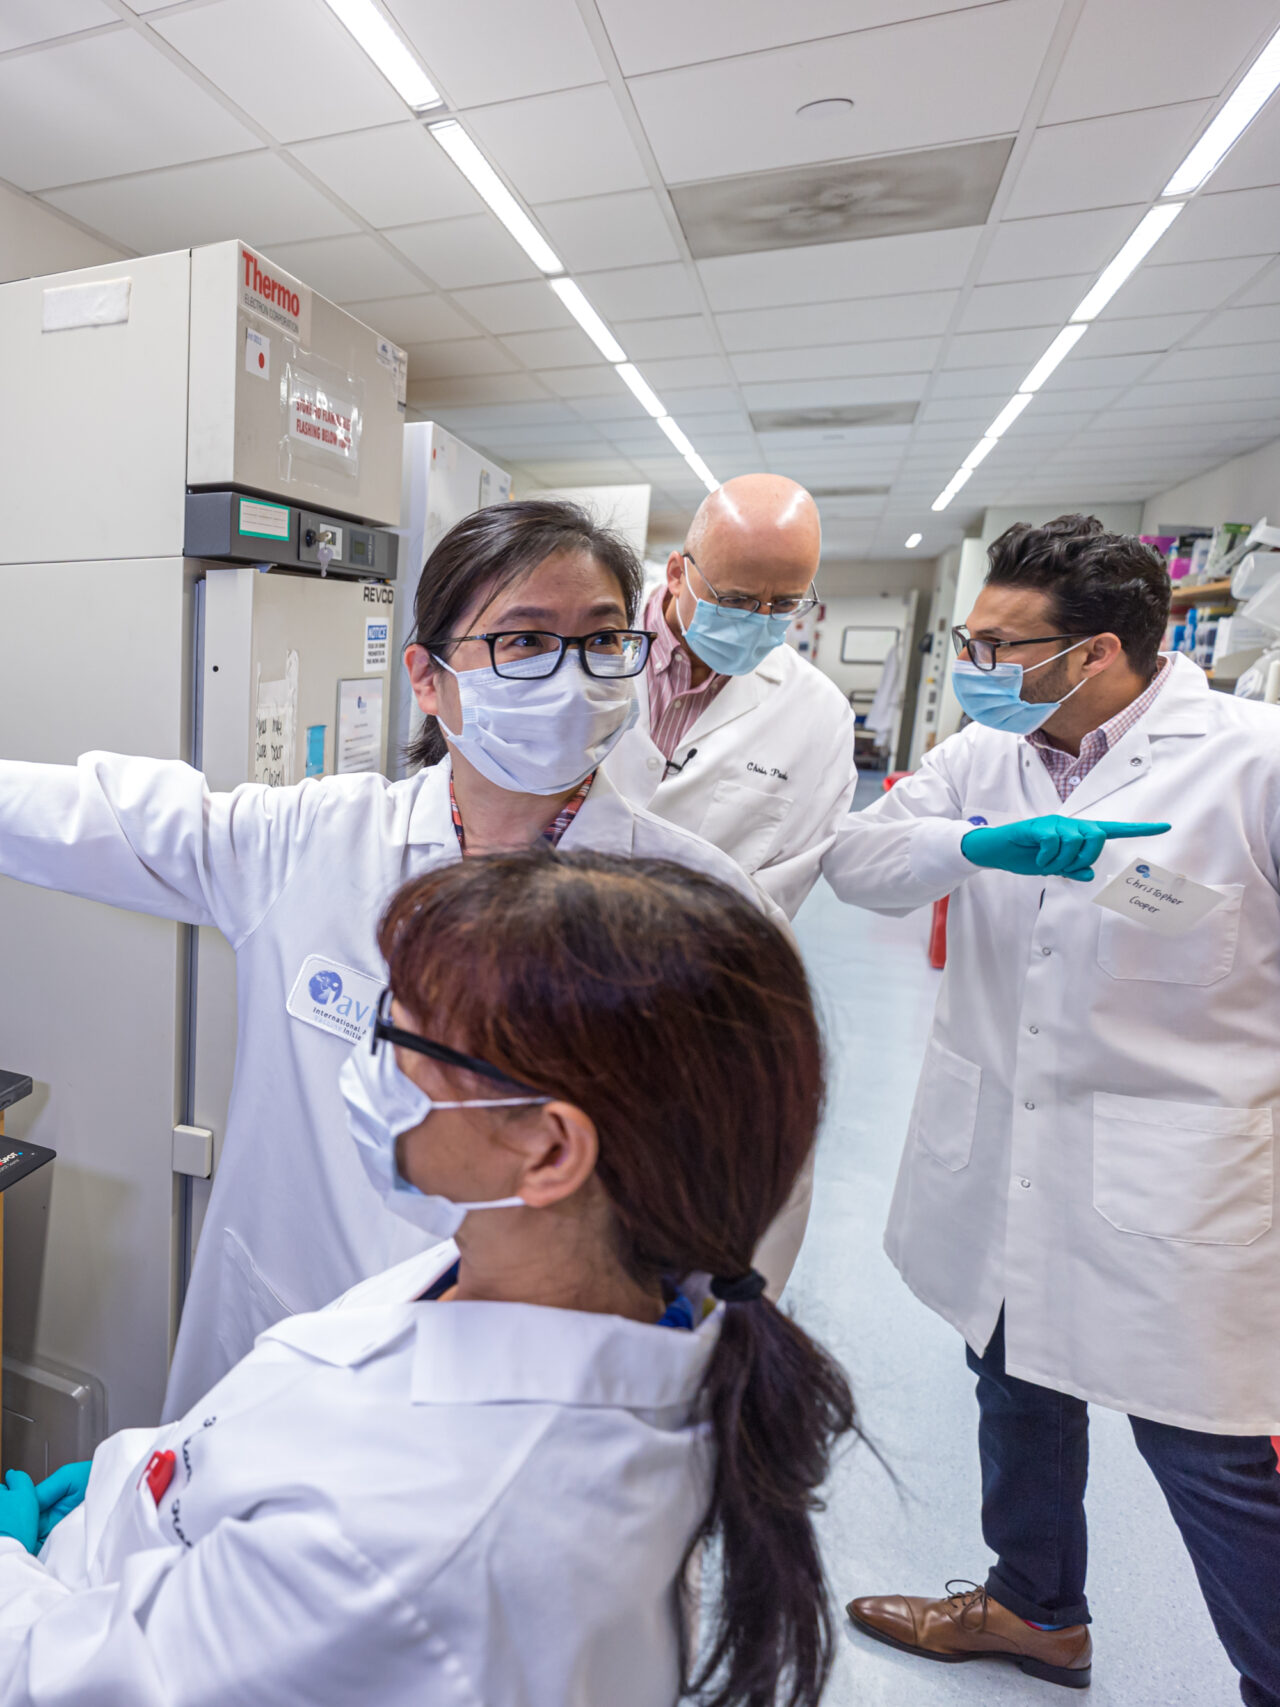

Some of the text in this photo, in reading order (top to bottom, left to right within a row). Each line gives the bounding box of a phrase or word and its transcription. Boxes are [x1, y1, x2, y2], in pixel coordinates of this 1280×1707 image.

[242, 250, 300, 317] Thermo
[363, 586, 394, 604] REVCO
[313, 1007, 360, 1033] International
